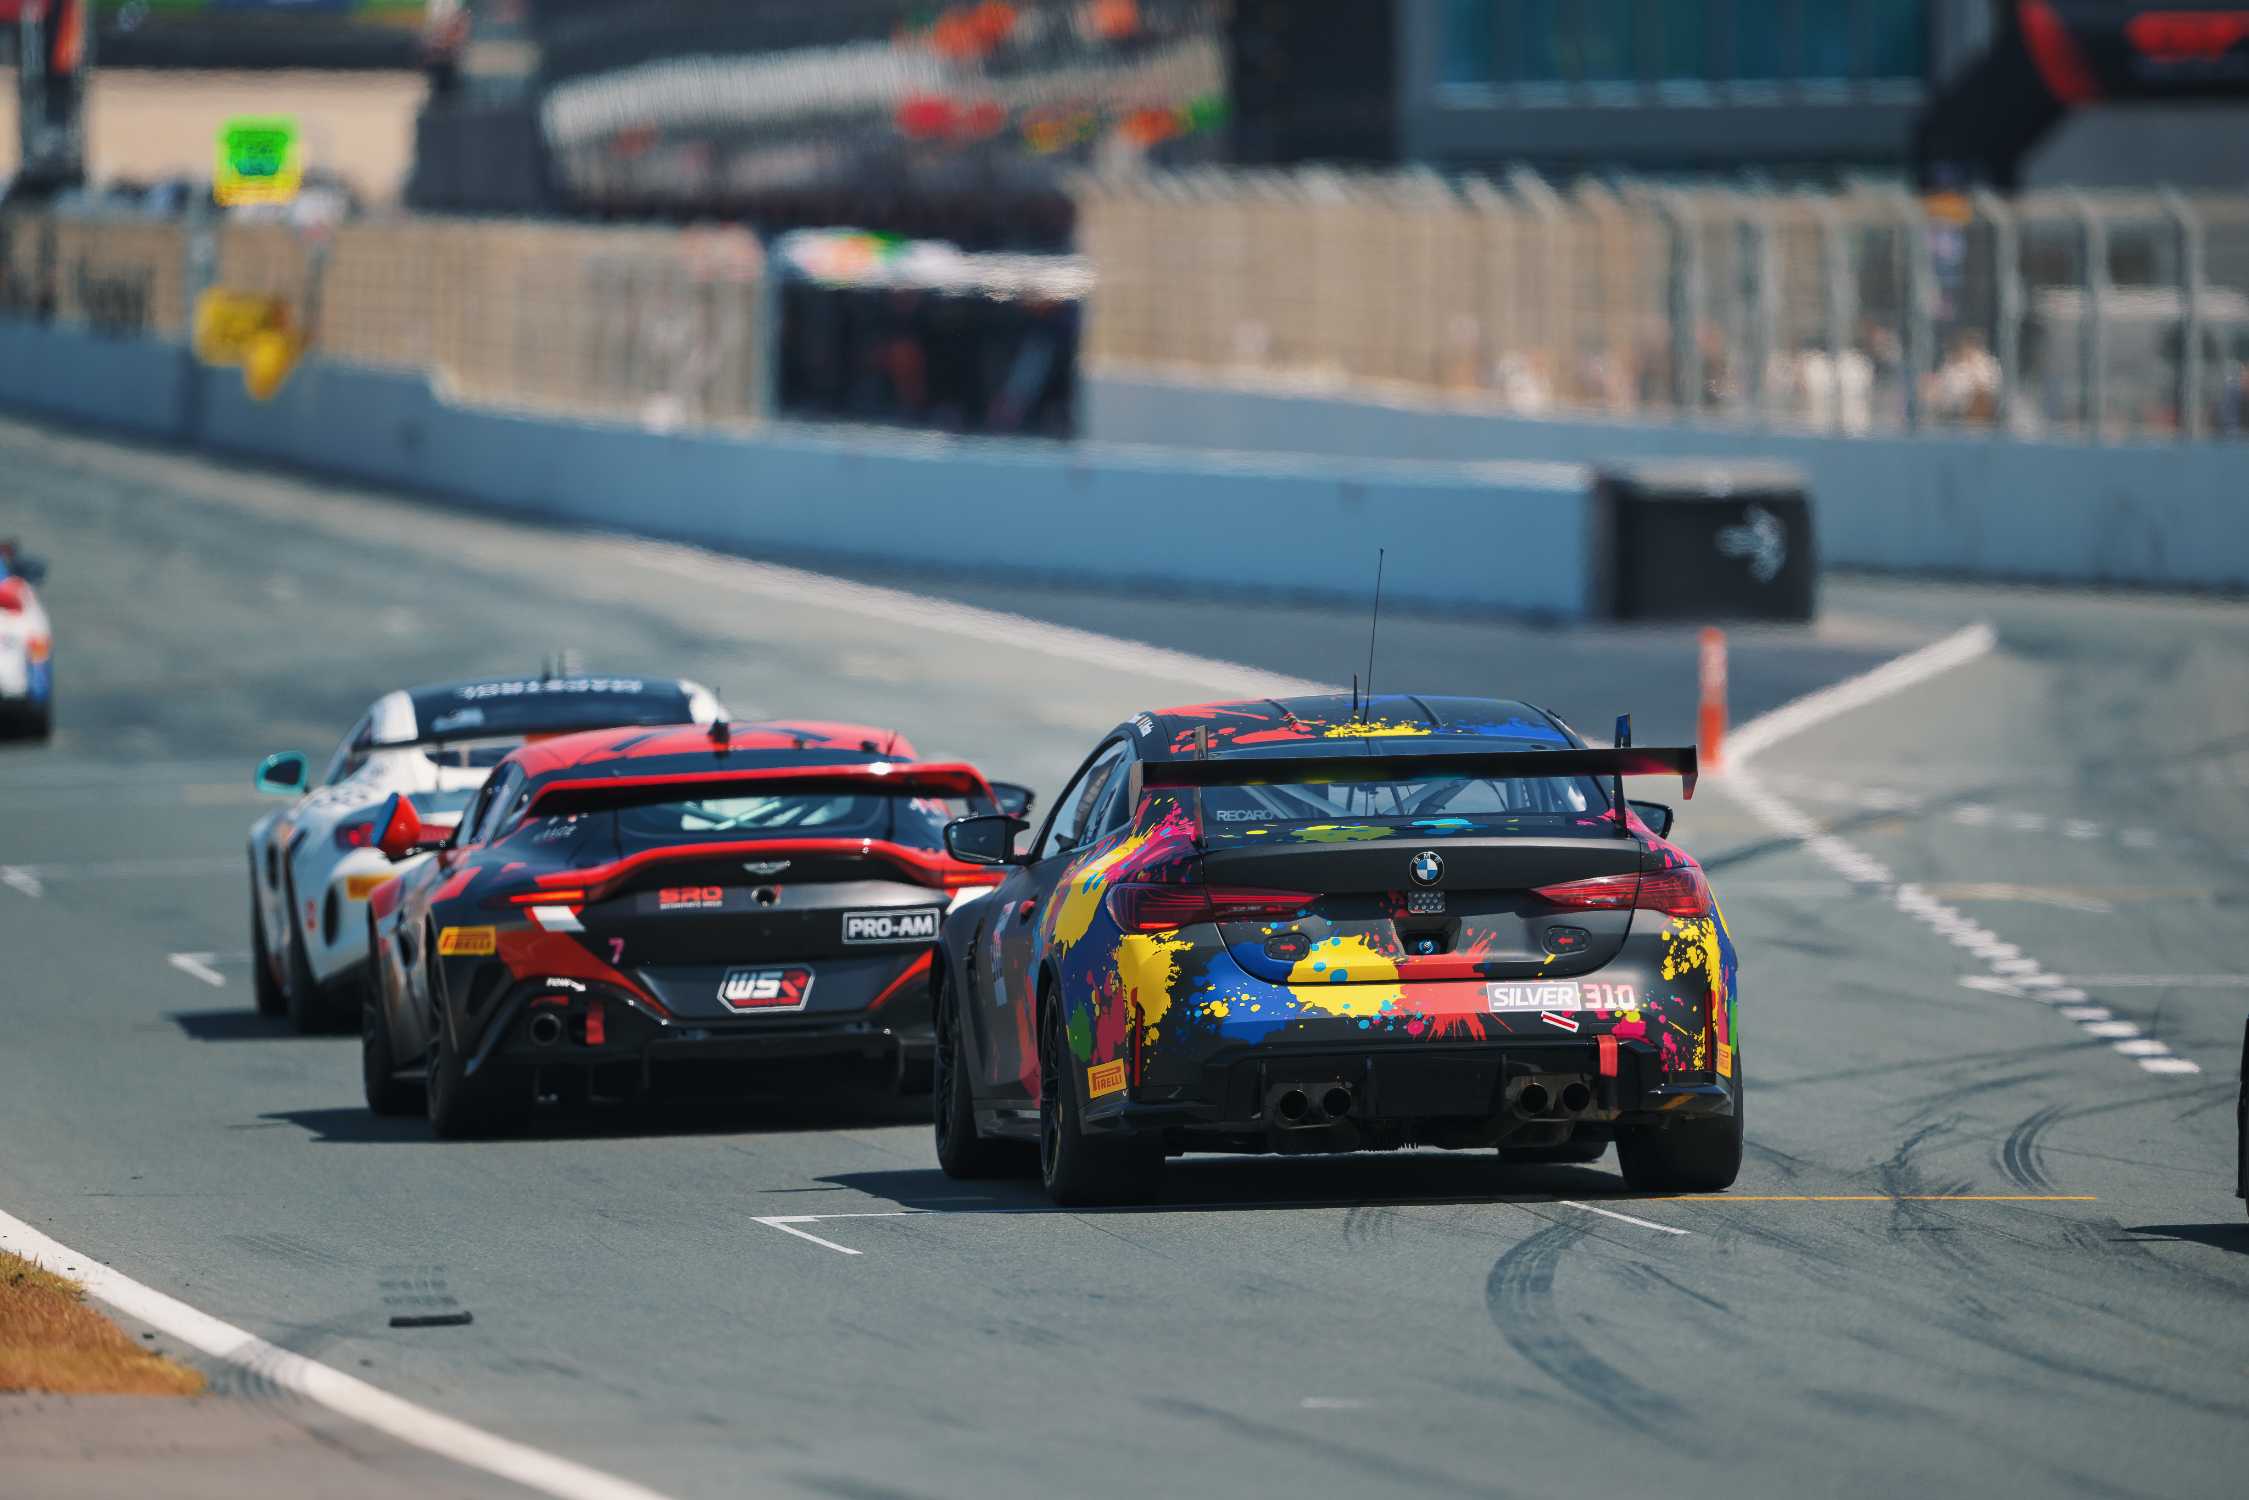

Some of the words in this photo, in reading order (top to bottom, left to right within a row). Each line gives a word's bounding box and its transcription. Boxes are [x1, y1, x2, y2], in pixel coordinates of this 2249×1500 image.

[1215, 808, 1274, 821] RECARO
[1413, 852, 1442, 864] BMW
[847, 914, 934, 938] PRO-AM
[608, 937, 624, 963] 7
[1493, 986, 1575, 1008] SILVER
[1582, 983, 1637, 1010] 310
[1092, 1066, 1122, 1091] PIRELLI
